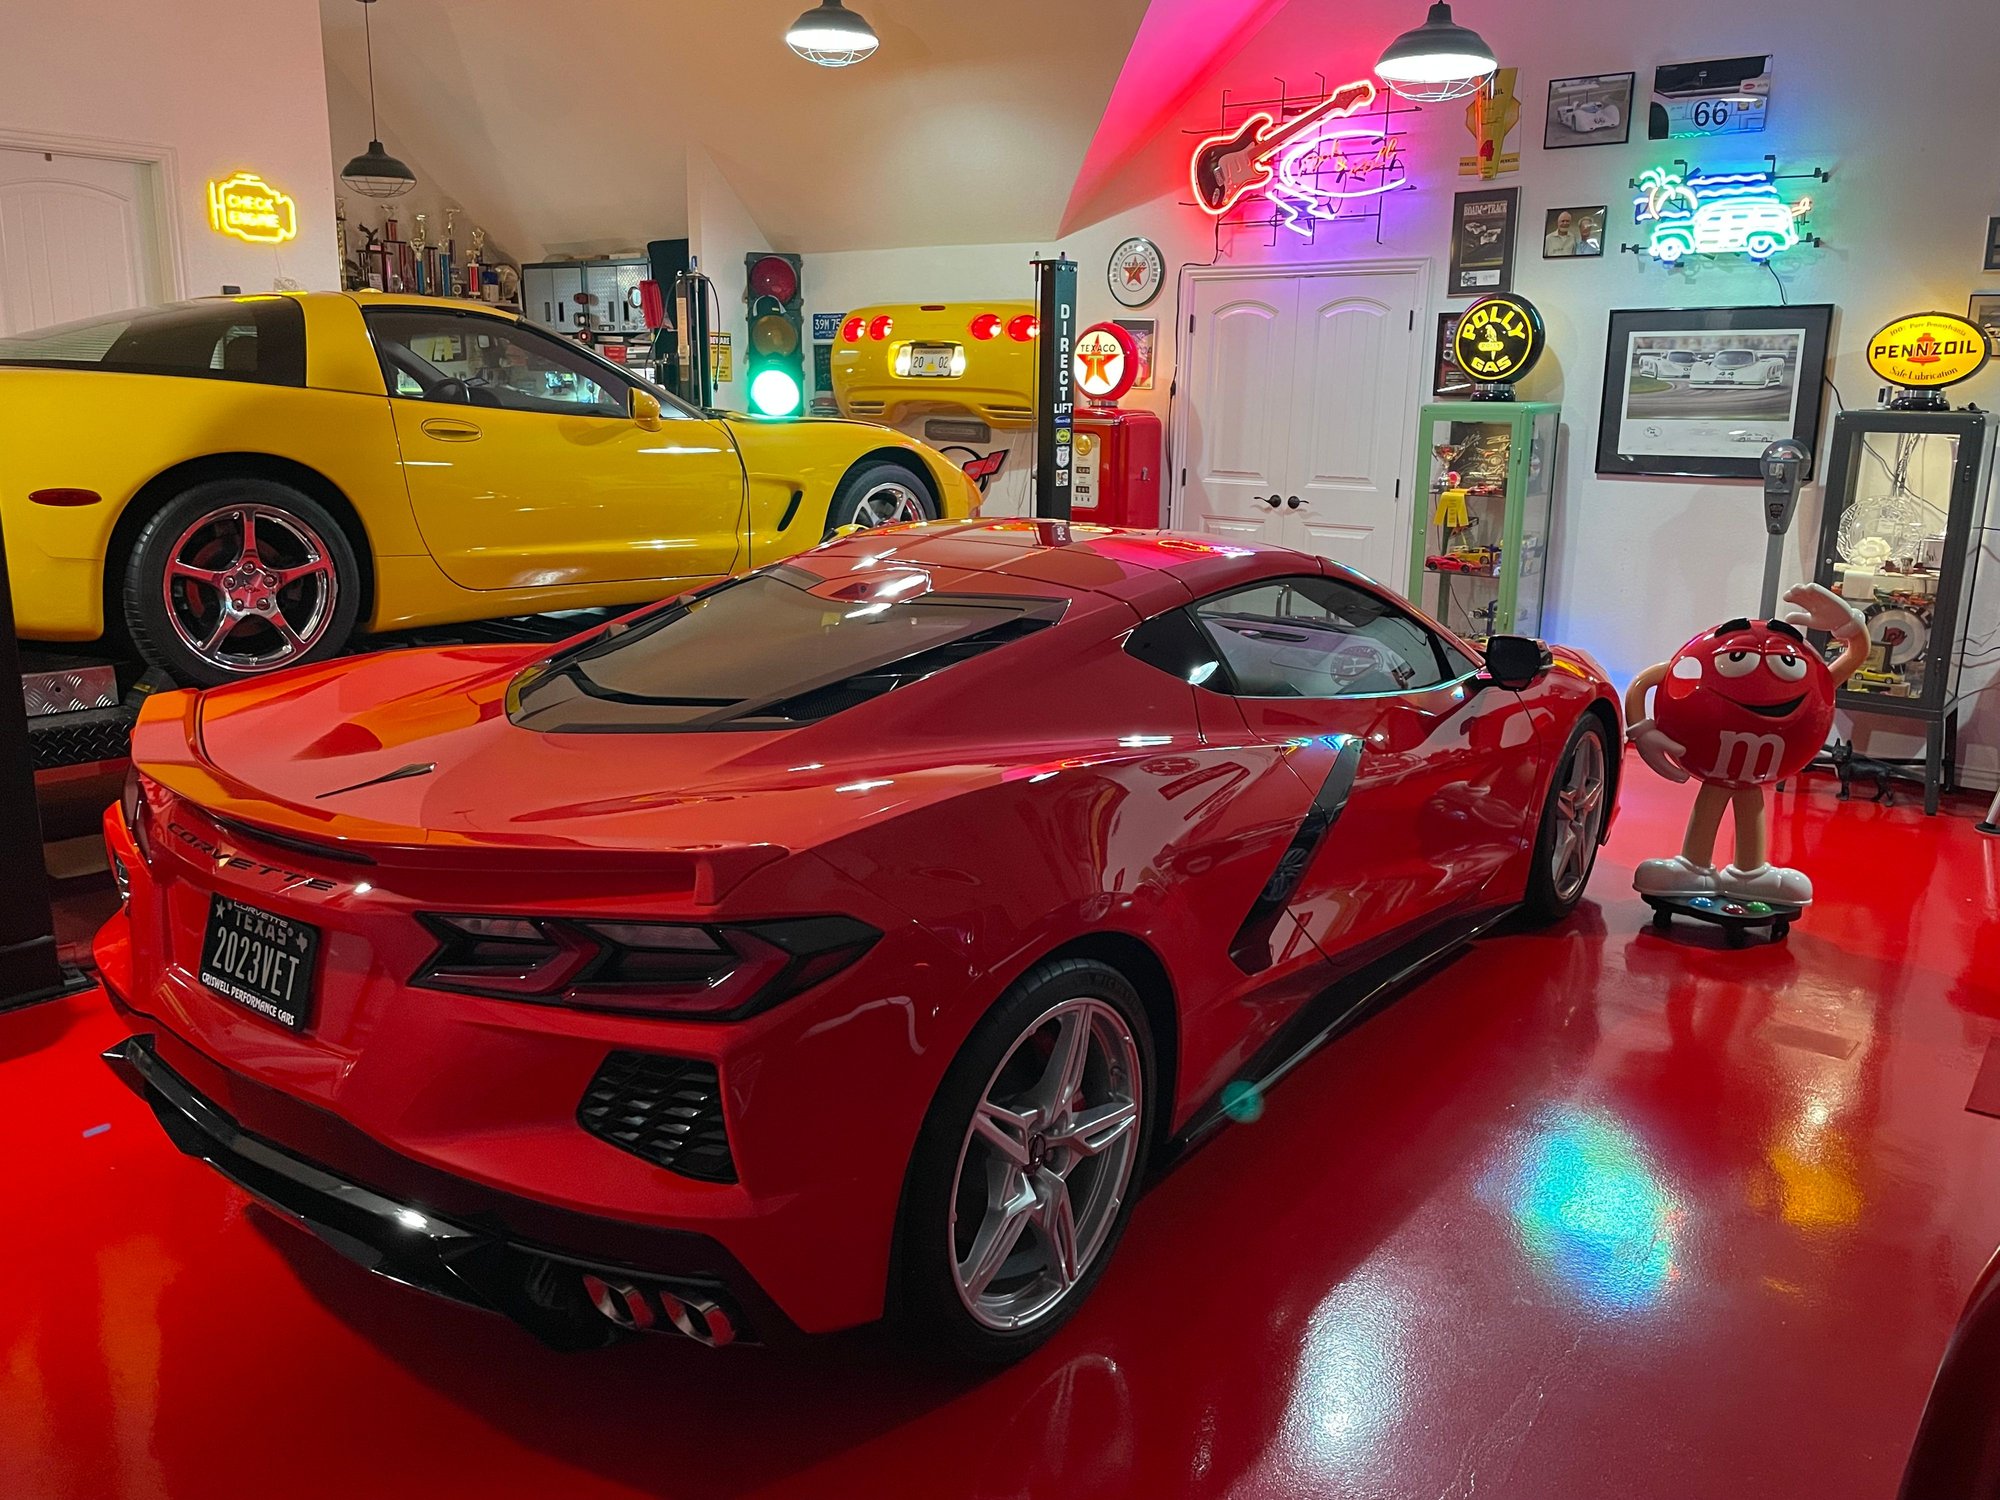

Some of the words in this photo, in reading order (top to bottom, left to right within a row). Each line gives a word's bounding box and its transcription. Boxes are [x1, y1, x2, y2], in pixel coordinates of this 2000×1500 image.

[1694, 101, 1728, 127] 66
[1480, 139, 1495, 162] 4
[226, 194, 275, 212] CHECK
[228, 210, 281, 229] ENGINE
[814, 318, 830, 331] 39M
[1462, 306, 1526, 340] POLLY
[1926, 321, 1967, 337] Pennsylvania
[1060, 304, 1070, 401] DIRECT
[1080, 344, 1117, 353] TEXACO
[1874, 340, 1977, 359] PENNZOIL
[913, 356, 925, 368] 20
[938, 356, 950, 368] 02
[1471, 355, 1512, 373] GAS
[1890, 366, 1908, 379] Safe
[1908, 367, 1958, 380] Lubrication
[1054, 403, 1073, 414] LIFT
[1706, 730, 1786, 784] m
[168, 822, 338, 892] CORVETTE
[235, 910, 287, 946] TEXAS
[212, 926, 299, 1001] 2023VET
[202, 972, 231, 995] CRISWELL
[230, 985, 278, 1018] PERFORMANCE
[277, 1008, 296, 1026] CARS
